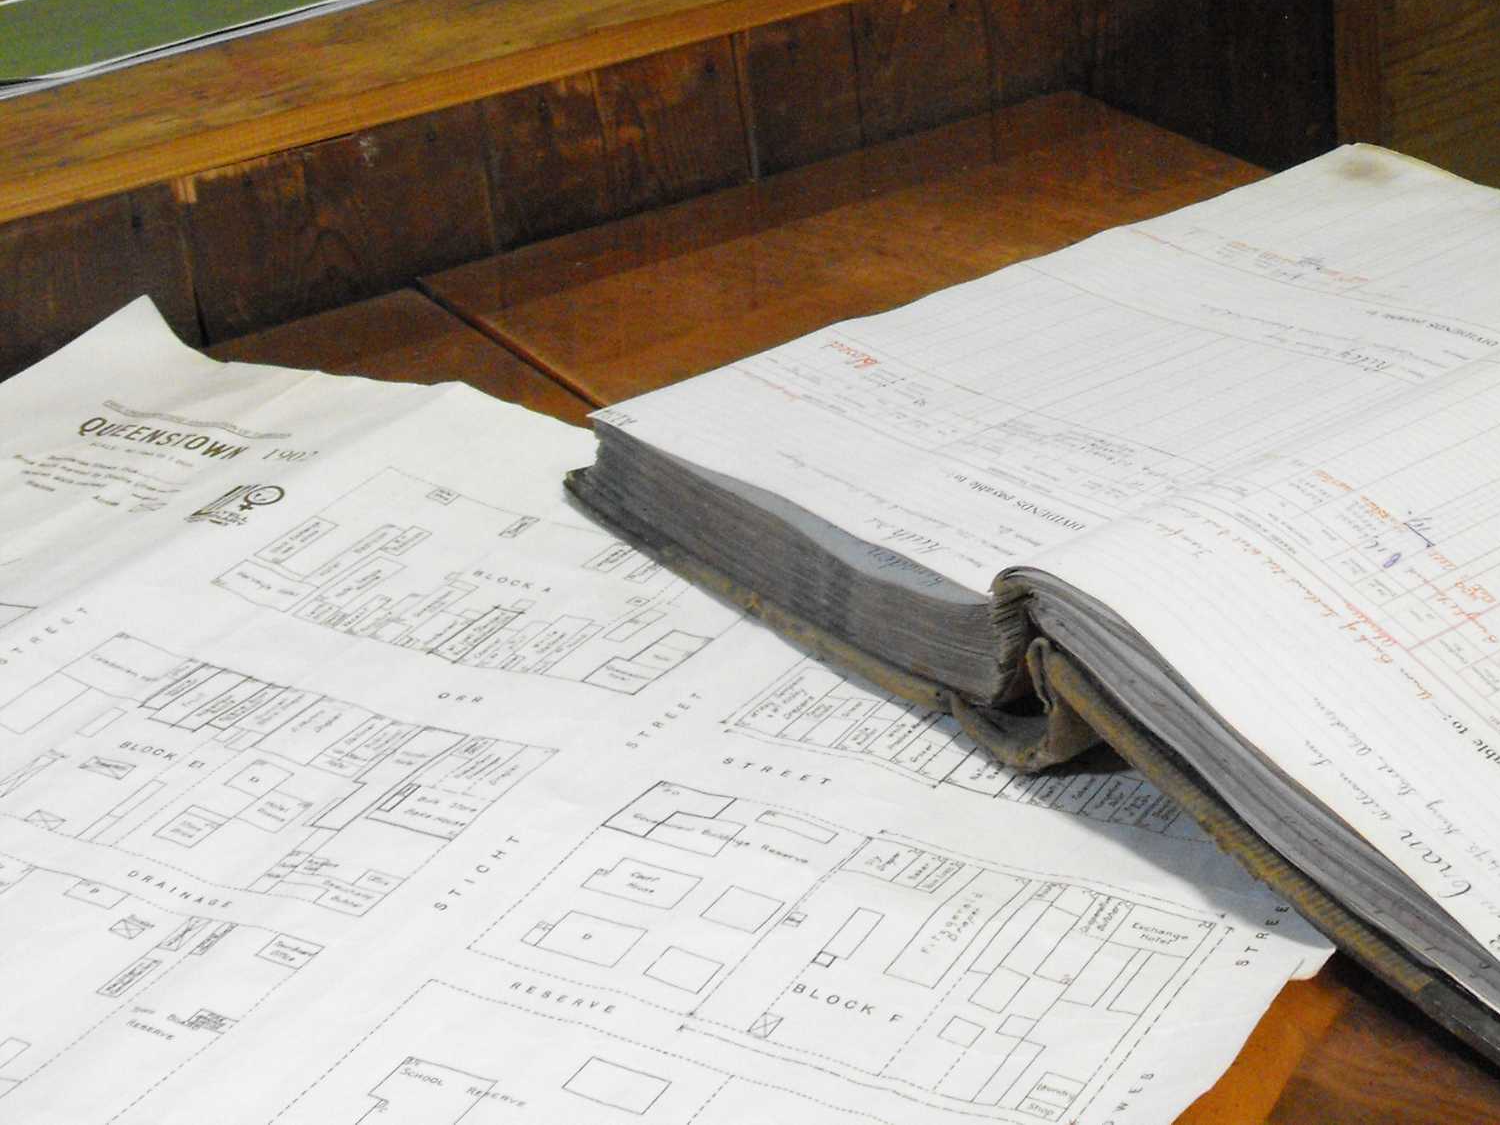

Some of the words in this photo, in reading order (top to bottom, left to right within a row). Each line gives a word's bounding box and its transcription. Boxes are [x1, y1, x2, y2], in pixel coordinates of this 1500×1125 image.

[79, 416, 249, 461] QUEENSTOWN
[473, 569, 534, 590] BLOCK
[119, 739, 178, 761] BLOCK
[722, 756, 832, 785] STREET
[433, 835, 520, 912] STICHT
[625, 692, 701, 750] STREET
[127, 869, 233, 909] DRAINAGE
[510, 980, 617, 1015] RESERVE
[1131, 921, 1190, 941] Exchange
[792, 982, 877, 1017] BLOCK
[888, 1012, 904, 1023] F
[400, 1066, 445, 1088] SCHOOL
[465, 1085, 529, 1109] RESERVE
